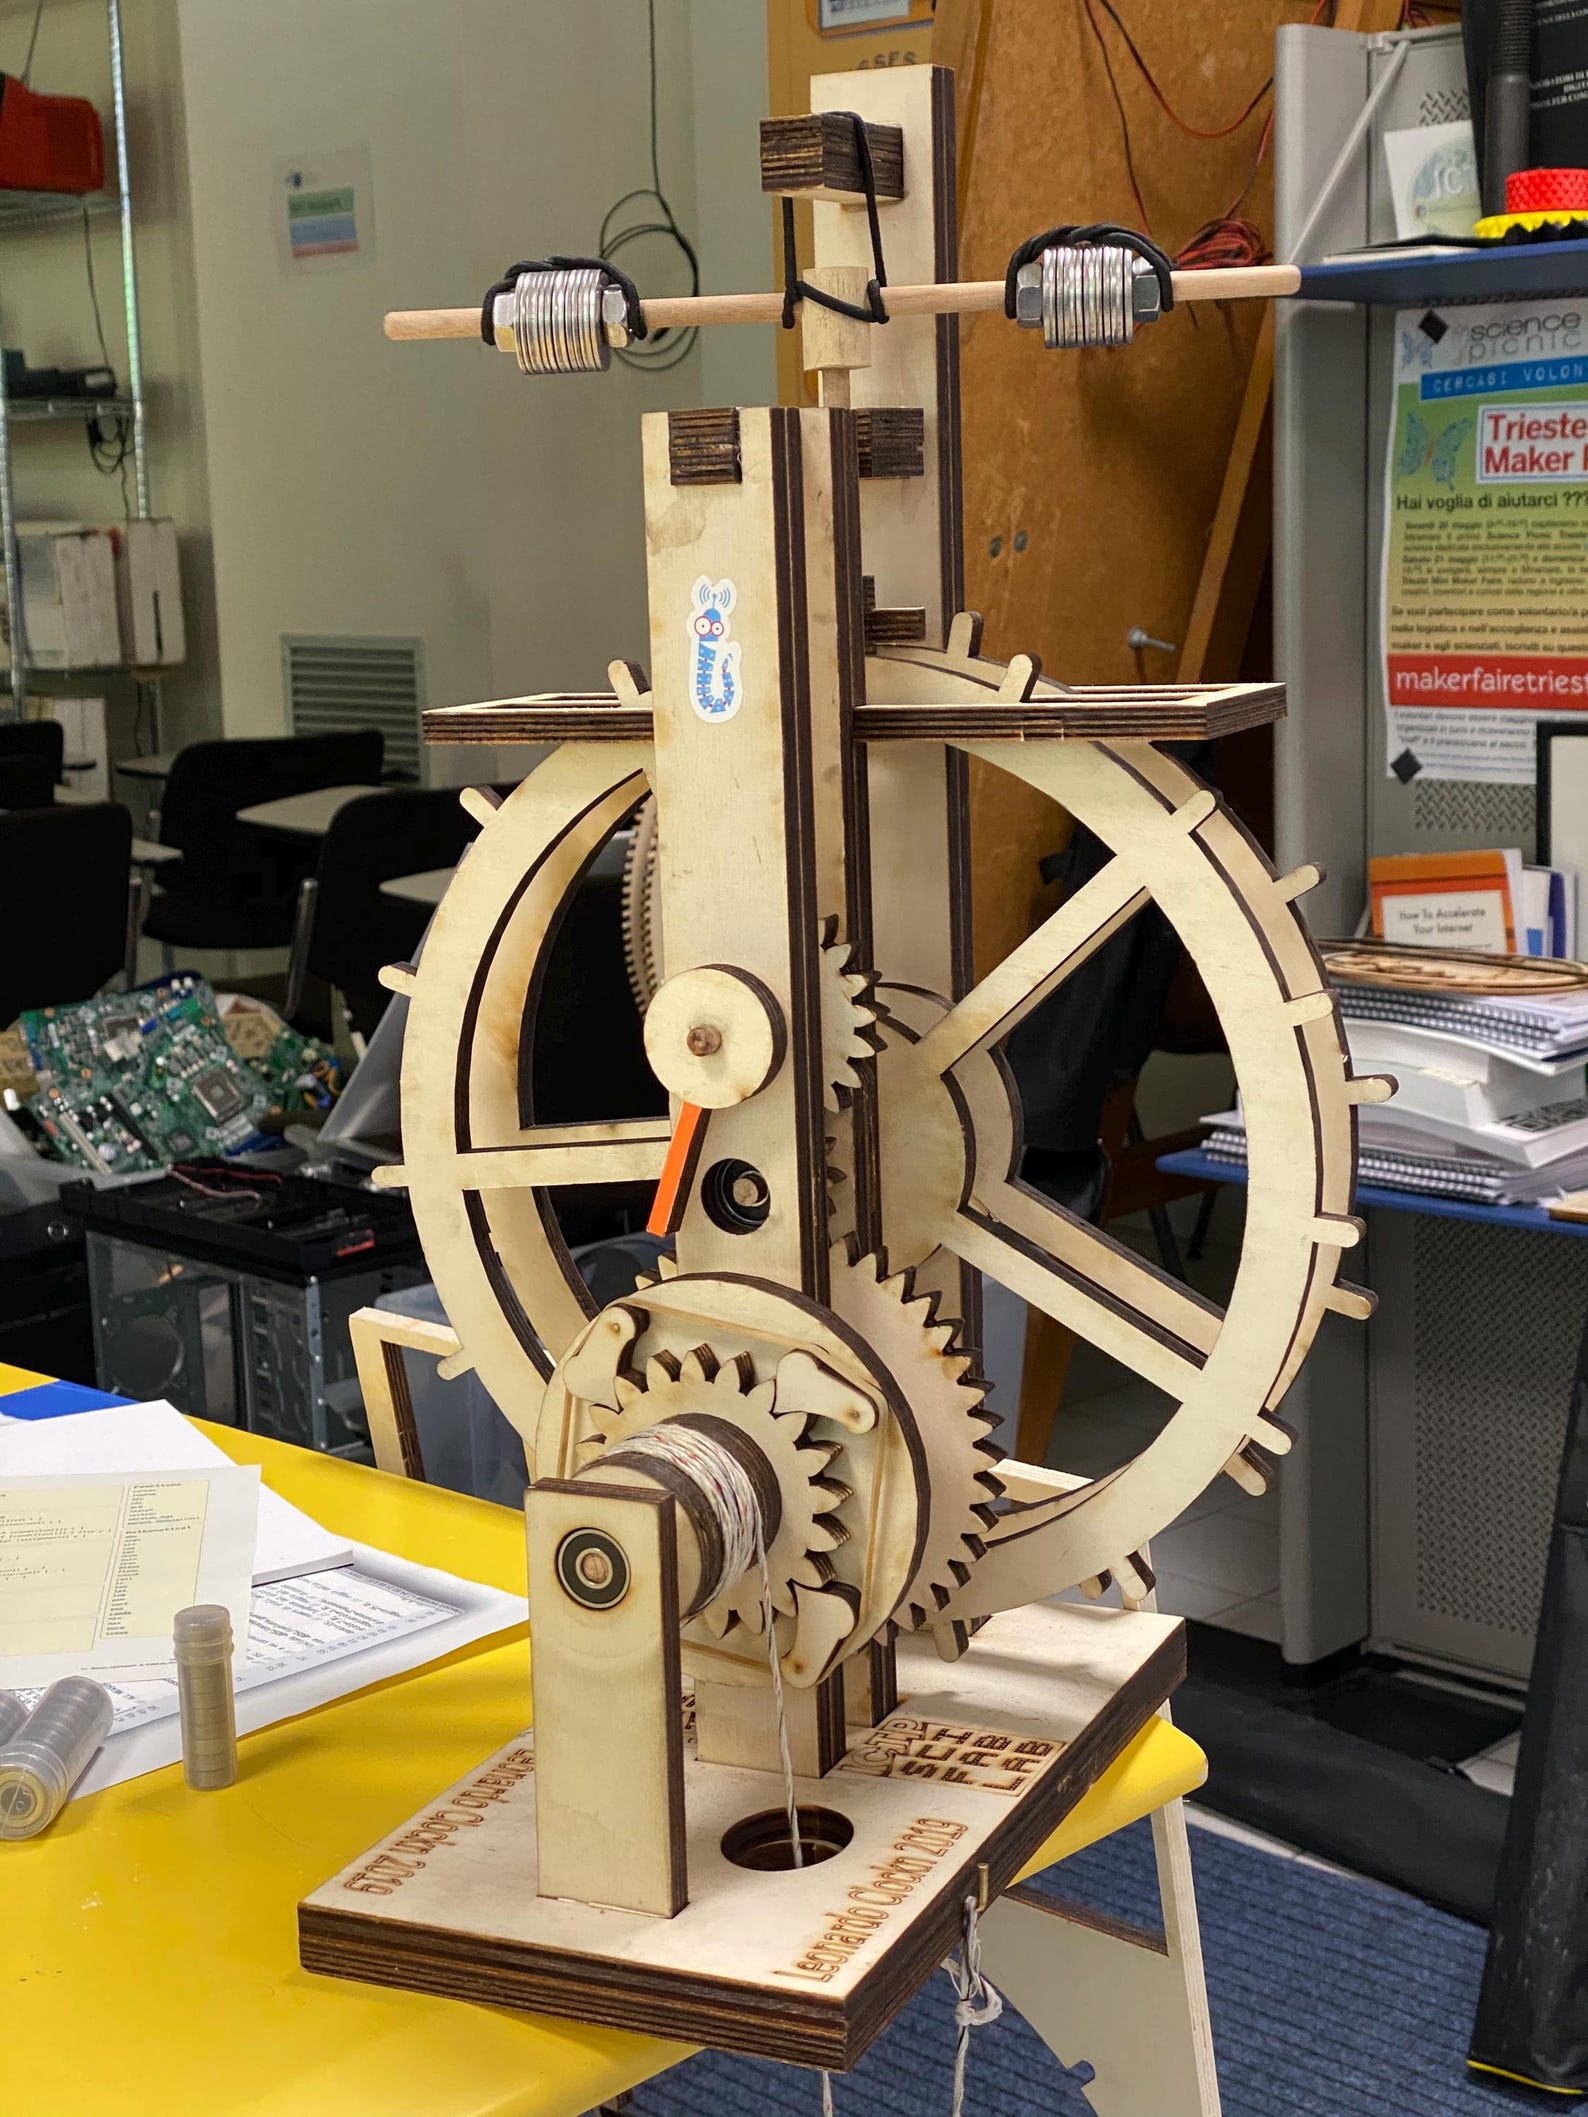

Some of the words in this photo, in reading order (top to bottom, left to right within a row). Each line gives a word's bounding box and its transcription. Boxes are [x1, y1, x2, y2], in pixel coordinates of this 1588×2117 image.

[1470, 312, 1581, 341] science
[1468, 330, 1581, 364] picnic
[1432, 370, 1507, 392] CERCASI
[1523, 363, 1588, 382] VOLON
[1487, 412, 1587, 442] Trieste
[1484, 444, 1575, 474] Maker
[1397, 494, 1422, 510] Hai
[1427, 493, 1473, 511] voglia
[1478, 492, 1492, 508] di
[1498, 491, 1558, 508] aiutarci
[1399, 910, 1419, 921] How
[1423, 908, 1433, 920] To
[1436, 906, 1486, 920] Accelerate
[1414, 924, 1435, 935] Your
[1437, 922, 1473, 933] Internet
[838, 1717, 927, 1777] ICTP
[900, 1727, 973, 1779] SCI
[941, 1734, 1009, 1786] FAB
[982, 1740, 1053, 1792] LAB
[344, 1854, 427, 1895] 2019
[773, 1907, 890, 1983] Leonardo
[894, 1817, 969, 1858] 2019
